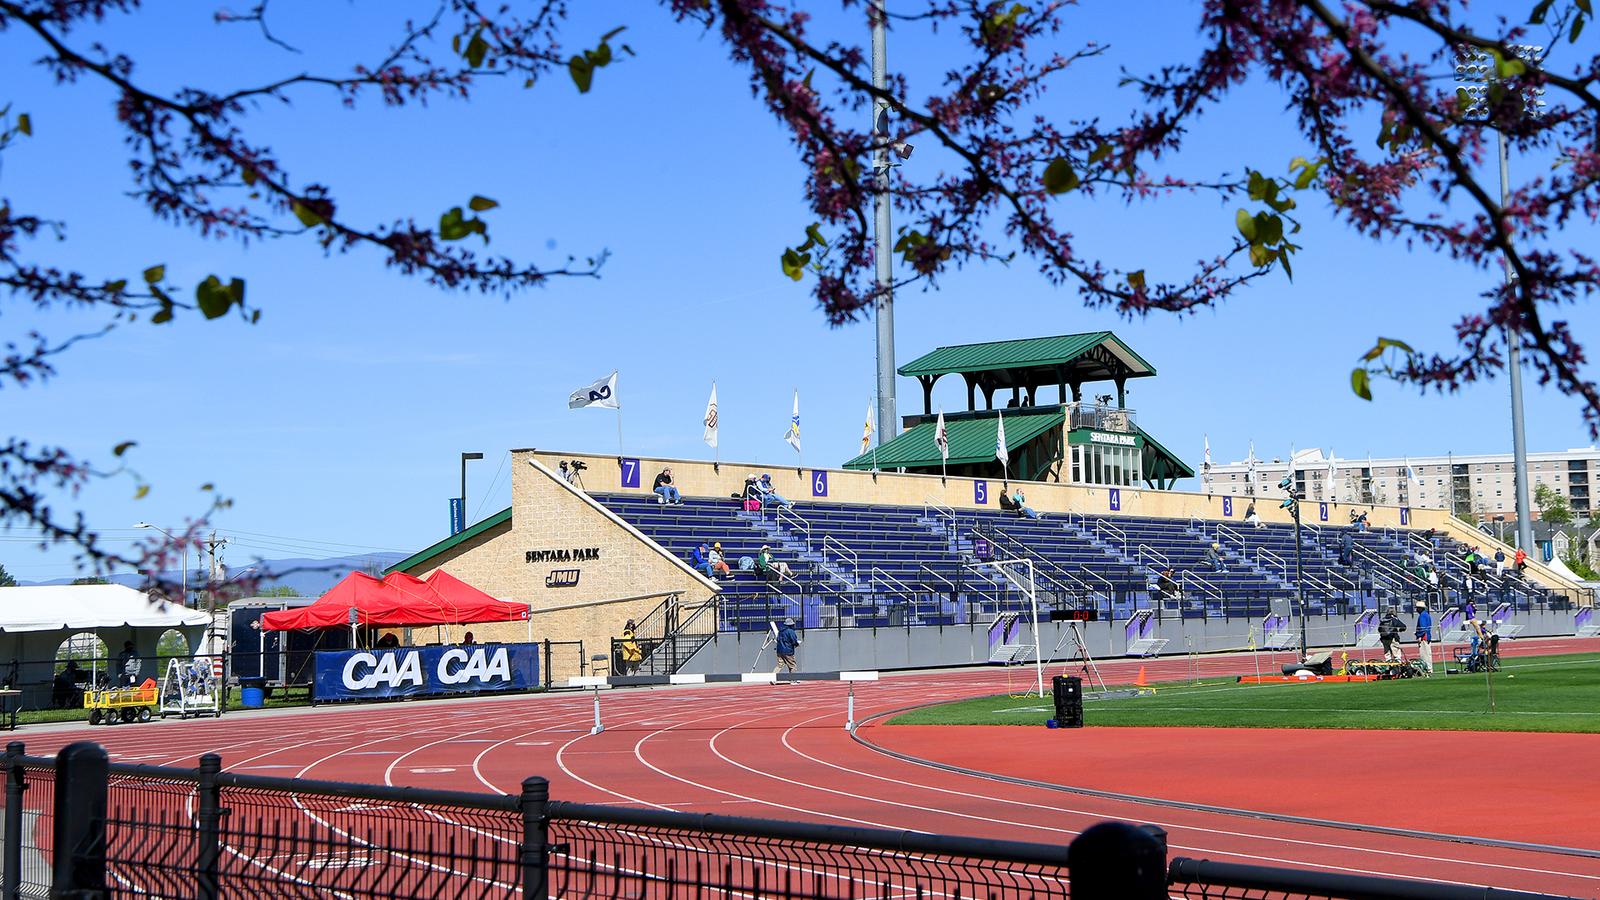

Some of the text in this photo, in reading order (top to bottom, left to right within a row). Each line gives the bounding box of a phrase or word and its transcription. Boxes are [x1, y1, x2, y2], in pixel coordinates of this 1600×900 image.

[1090, 432, 1136, 446] SENTARA PARK
[625, 461, 636, 484] 7
[815, 473, 825, 494] 6
[977, 482, 985, 502] 5
[1111, 490, 1119, 508] 4
[1225, 498, 1231, 514] 3
[1321, 504, 1327, 520] 2
[1402, 510, 1408, 524] 1
[525, 548, 600, 563] SENTARA PARK
[546, 570, 580, 586] JMU
[342, 648, 511, 690] CAA CAA
